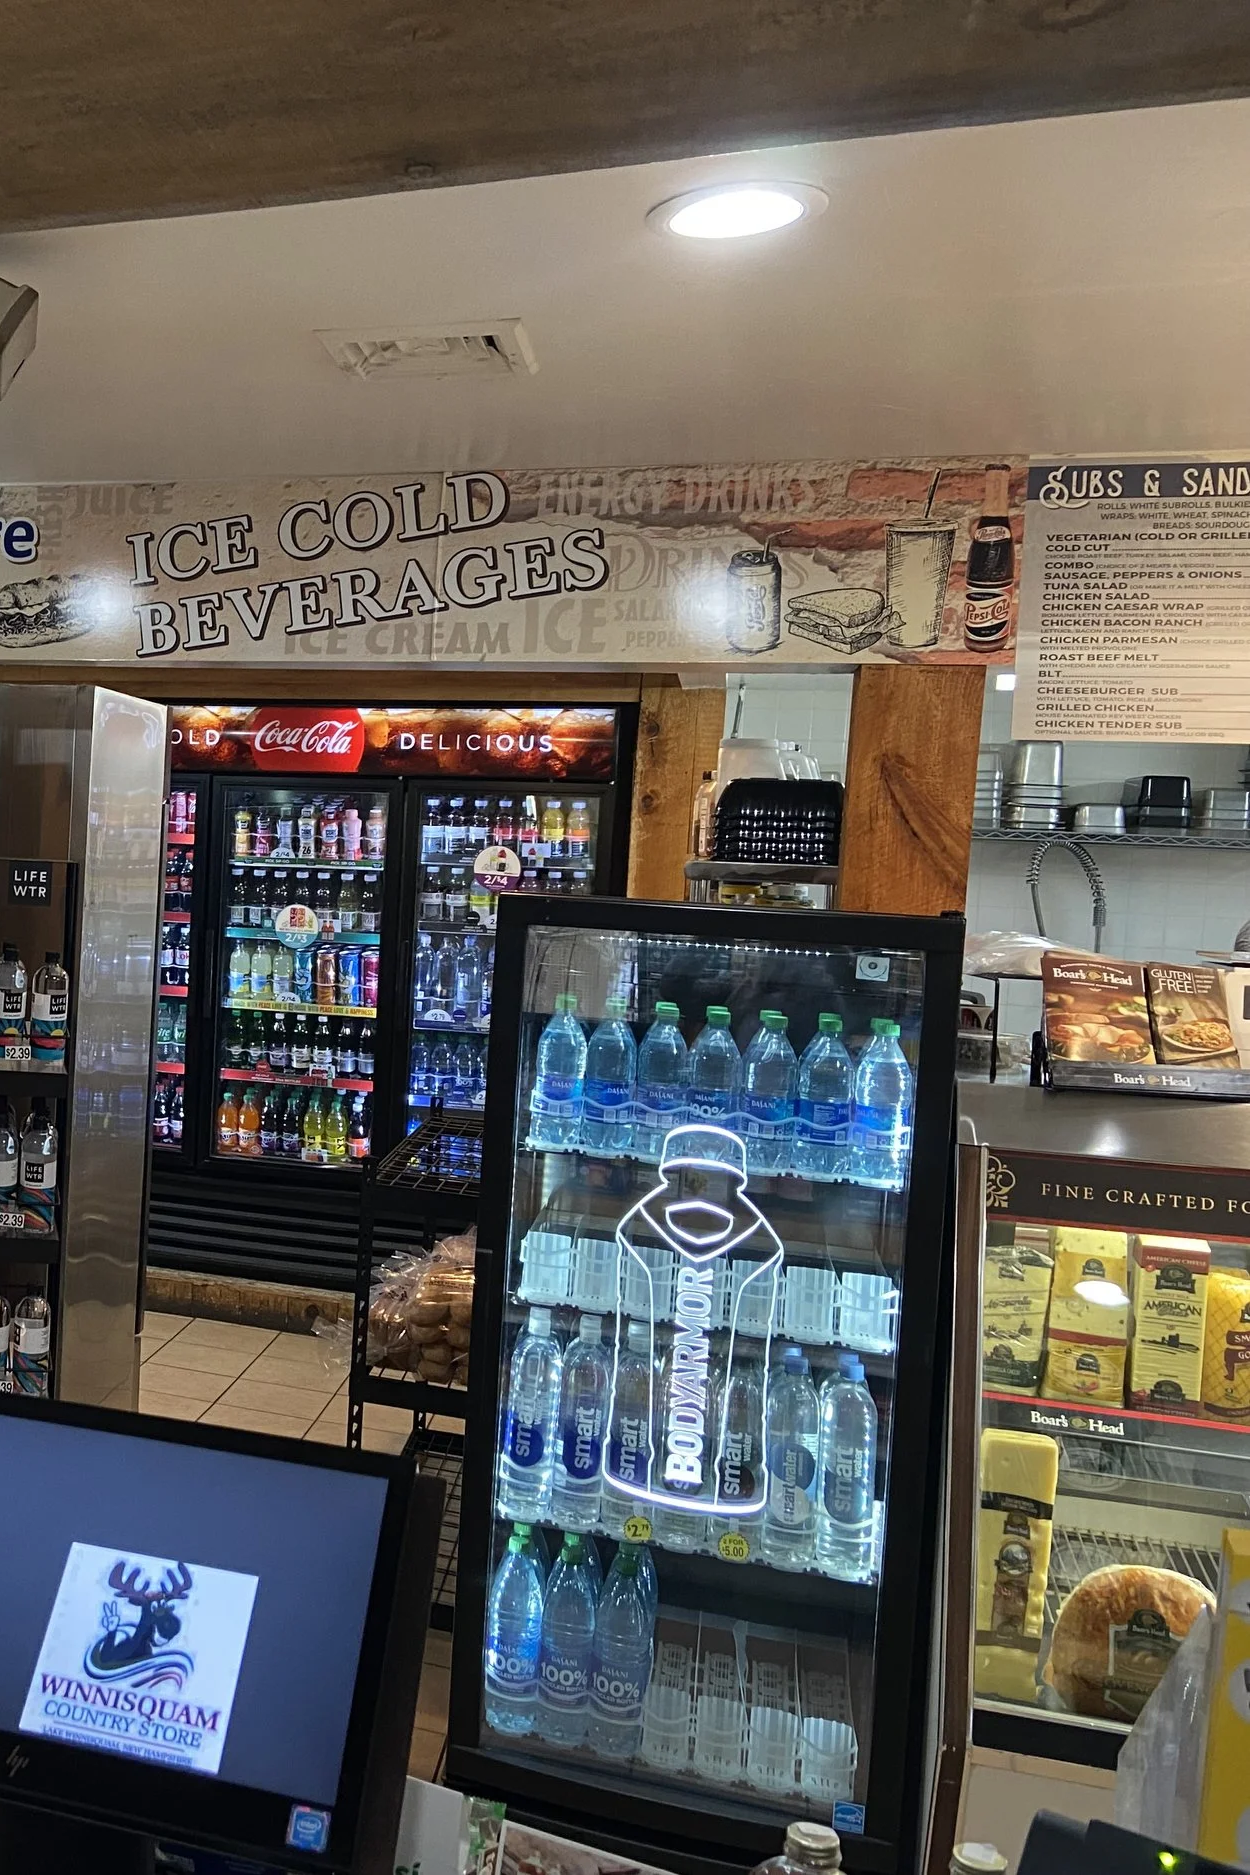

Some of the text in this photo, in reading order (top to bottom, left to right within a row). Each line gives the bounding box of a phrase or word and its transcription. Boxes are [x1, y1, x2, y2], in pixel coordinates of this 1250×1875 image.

[1039, 465, 1124, 509] SUBS
[1143, 469, 1161, 497] &
[1129, 502, 1159, 510] WHITE
[126, 470, 512, 588] ICE COLD
[1046, 532, 1198, 543] VEGETARIAN OR
[1045, 543, 1111, 553] COLD CUT
[608, 533, 810, 592] DRINS
[1044, 561, 1094, 570] COMBO
[1044, 570, 1243, 581] SAUSAGE, PEPPERS & ONIONS
[1043, 582, 1128, 591] TUNA SALAD
[132, 529, 610, 659] BEVERAGES
[1042, 592, 1150, 601] CHICKEN SALAD
[1041, 603, 1101, 611] CHICKEN
[1104, 603, 1159, 611] CAESAR
[1162, 603, 1204, 611] WRAP
[523, 598, 607, 656] ICE
[1041, 619, 1203, 627] CHICKEN BACON RANCH
[283, 617, 512, 656] ICE CREAM
[1040, 636, 1100, 645] CHICKEN
[1102, 636, 1178, 645] PARMESAN
[1039, 653, 1160, 662] ROAST BEEF MELT
[1038, 670, 1063, 678] BLT
[1037, 686, 1179, 696] CHEESEBURGER SUB
[1036, 703, 1155, 712] GRILLED CHICKEN
[1035, 720, 1183, 729] CHICKEN TENDER SUB
[254, 719, 360, 755] Coca-Cola
[399, 732, 554, 753] DELICIOUS
[13, 870, 48, 883] LIFE
[13, 885, 48, 898] WTR
[1052, 967, 1087, 981] Boar's
[1102, 973, 1133, 987] Head
[1150, 967, 1192, 982] GLUTEN
[1157, 978, 1194, 995] FREE
[5, 1046, 31, 1060] $2.39
[1114, 1072, 1192, 1088] Boar's Head
[25, 1164, 44, 1173] LIFE
[25, 1172, 44, 1182] WTR
[1040, 1183, 1095, 1201] FINE
[1105, 1189, 1216, 1212] CRAFTED
[1143, 1300, 1203, 1317] AMERICAN
[664, 1265, 714, 1484] BODYARMOR
[1030, 1410, 1125, 1436] Boar's Head
[574, 1406, 595, 1470] smart
[618, 1416, 640, 1481] smart
[723, 1430, 744, 1496] smart
[834, 1445, 854, 1512] smart
[721, 1536, 745, 1547] 2 FOR
[721, 1544, 745, 1558] $5.00
[551, 1656, 579, 1667] DASANI
[541, 1661, 588, 1686] 100%
[601, 1665, 629, 1679] DASANI
[592, 1672, 640, 1698] 100%
[40, 1672, 222, 1733] WINNISQUAM
[43, 1700, 203, 1749] COUNTRY STORE
